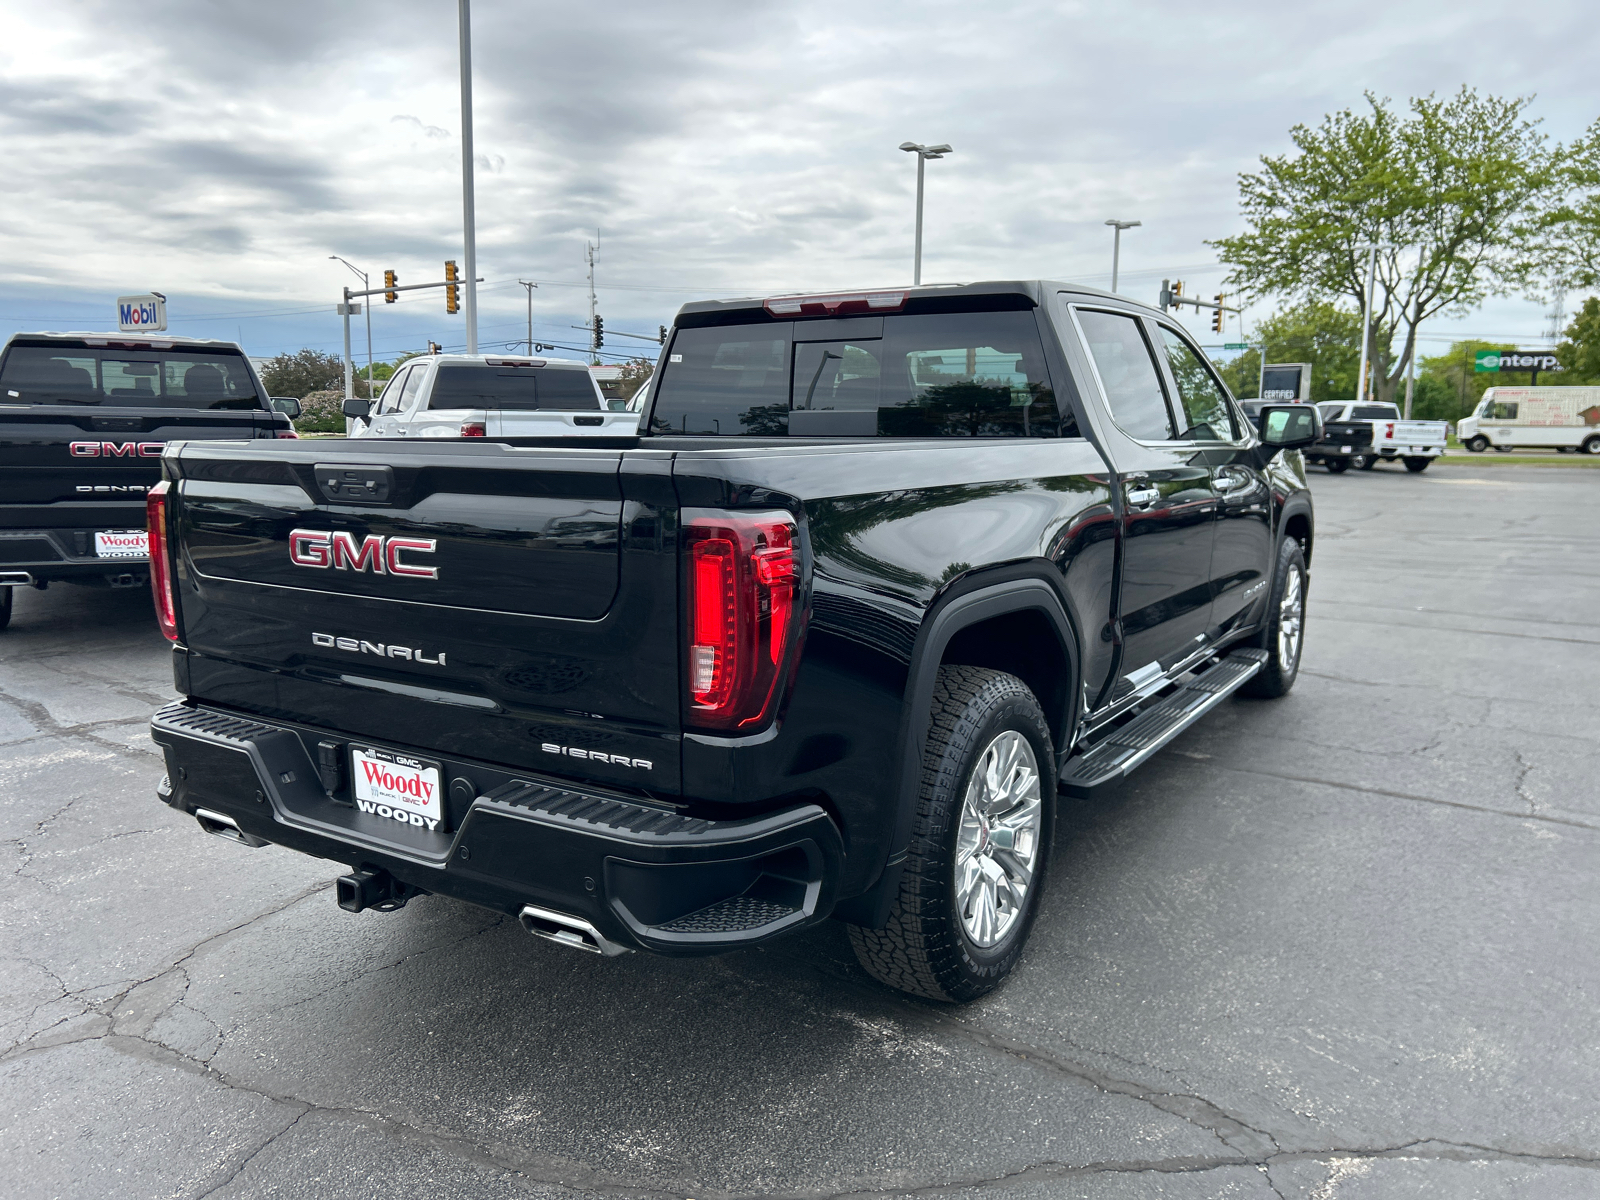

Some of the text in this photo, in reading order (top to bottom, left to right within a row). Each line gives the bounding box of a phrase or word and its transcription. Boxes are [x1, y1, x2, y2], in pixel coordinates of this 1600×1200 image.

[120, 303, 157, 325] Mobil
[1476, 354, 1558, 370] enterp
[1263, 389, 1295, 400] CERTIFIED
[69, 441, 167, 458] GMC
[99, 535, 149, 548] Woody
[289, 528, 440, 580] GMC
[311, 631, 447, 666] DENALI
[396, 756, 419, 767] GMC
[541, 742, 654, 771] SIERRA
[361, 760, 434, 805] Woody
[402, 796, 421, 806] GMC
[356, 799, 439, 831] WOODY
